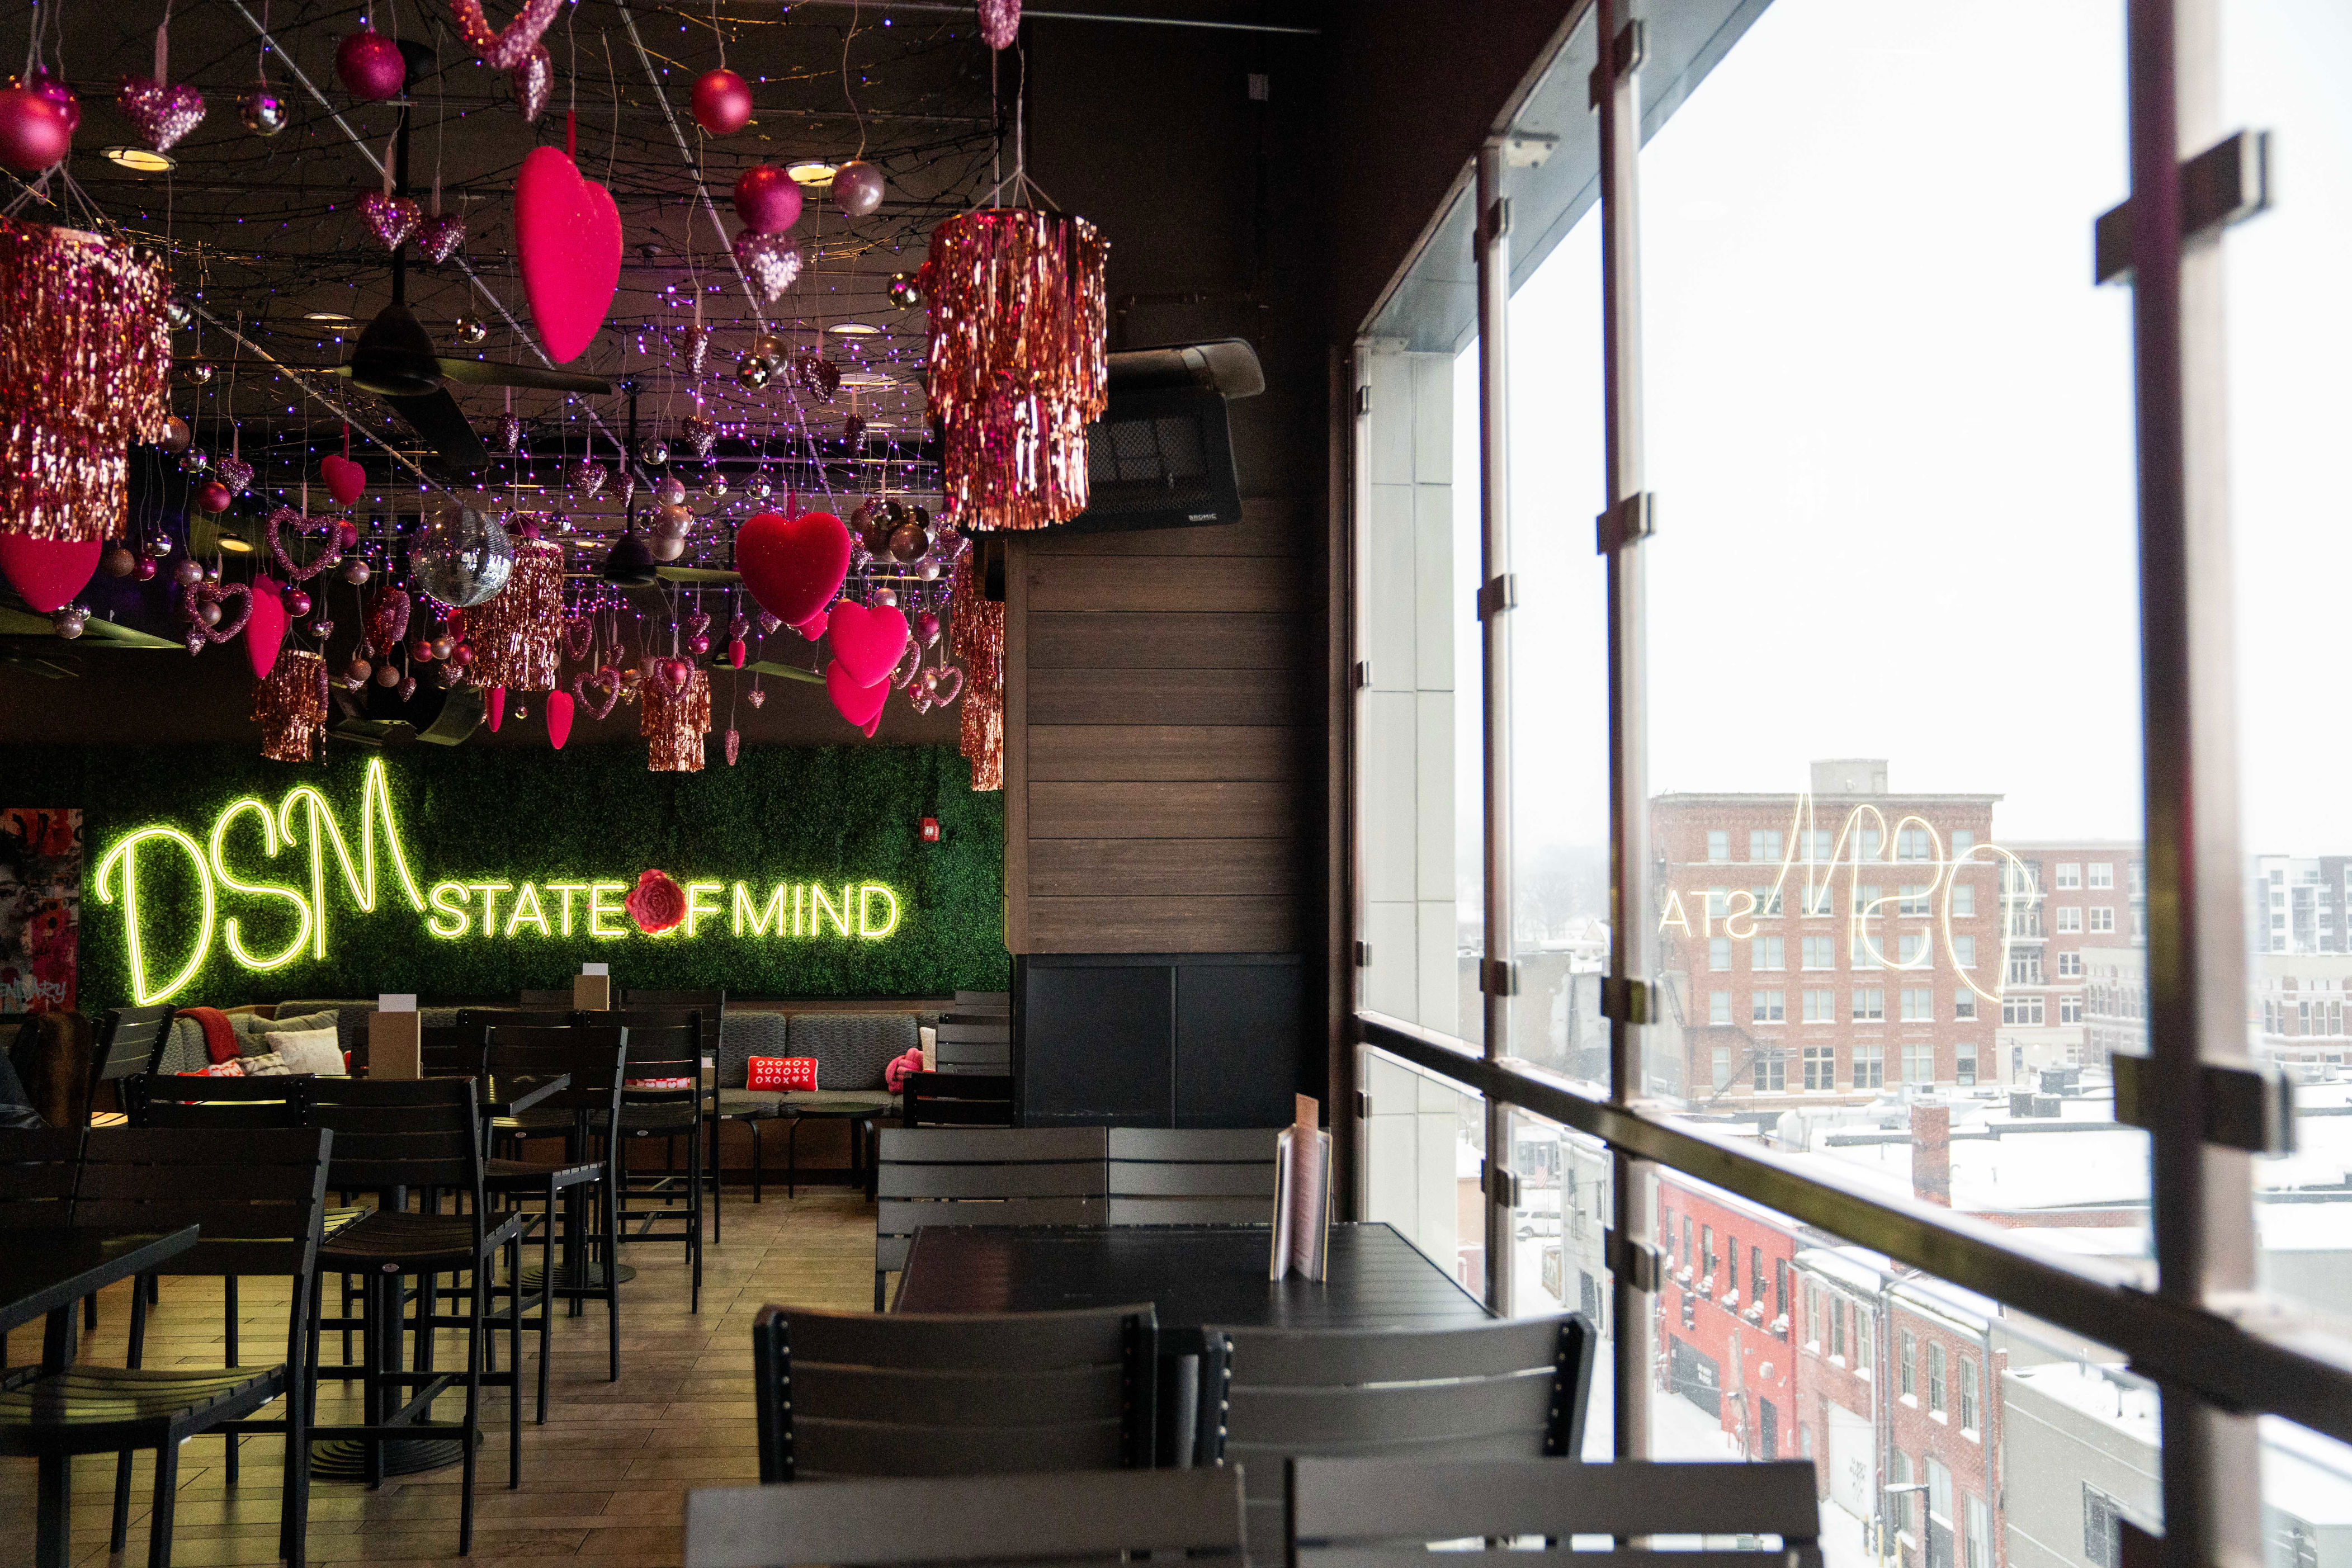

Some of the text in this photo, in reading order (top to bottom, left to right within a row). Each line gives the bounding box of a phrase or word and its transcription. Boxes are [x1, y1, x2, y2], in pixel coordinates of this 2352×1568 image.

[96, 757, 426, 1006] DSM
[428, 881, 627, 938] STATE
[733, 881, 899, 938] MIND
